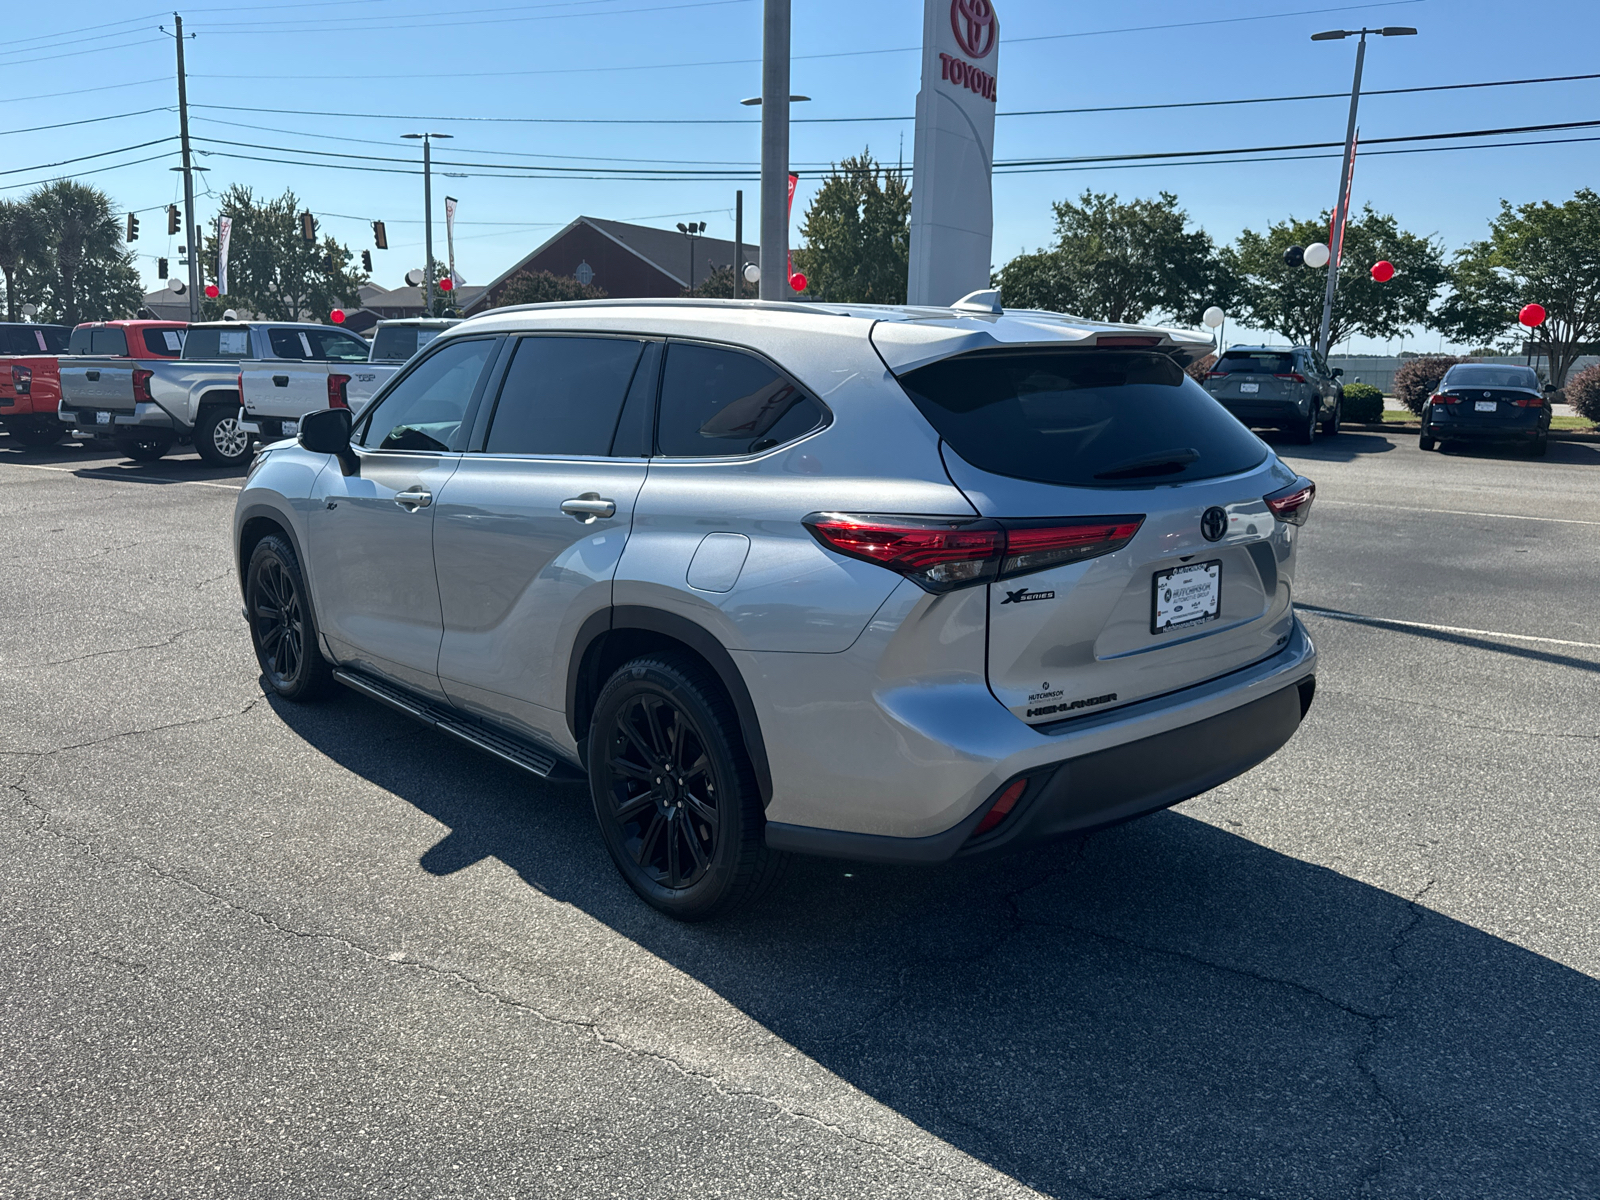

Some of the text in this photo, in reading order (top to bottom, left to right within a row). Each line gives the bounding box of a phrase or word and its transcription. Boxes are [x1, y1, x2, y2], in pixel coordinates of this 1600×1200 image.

[939, 52, 997, 102] TOYOTA
[71, 388, 122, 397] TACOMA
[255, 394, 314, 405] TACOMA
[1000, 588, 1054, 605] X SERIES
[1173, 582, 1211, 598] HUTCHINSON
[1028, 690, 1064, 701] HUTCHINSON
[1026, 693, 1117, 717] HIGHLANDER
